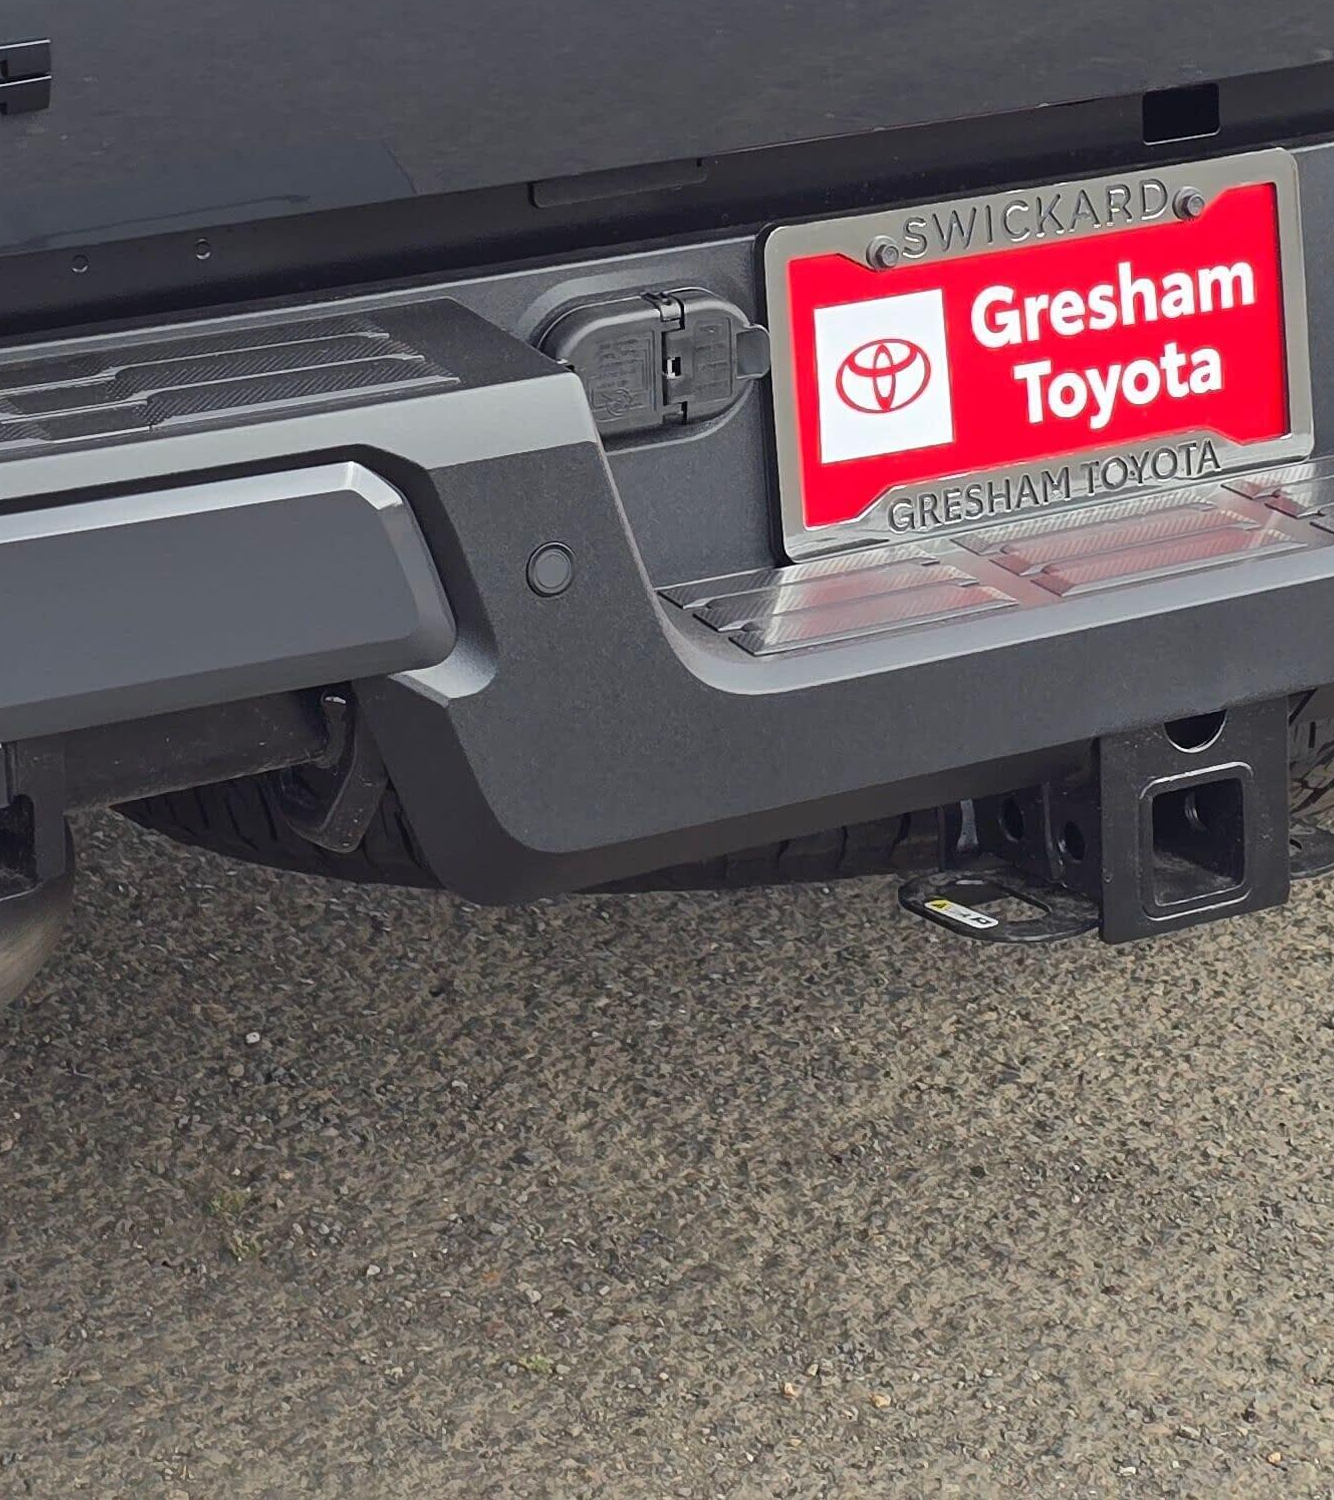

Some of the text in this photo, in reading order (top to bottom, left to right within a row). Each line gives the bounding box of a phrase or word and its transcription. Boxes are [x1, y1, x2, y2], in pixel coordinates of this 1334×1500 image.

[901, 177, 1169, 260] SWICKARD
[970, 260, 1256, 349] Gresham
[1013, 342, 1224, 430] Toyota
[887, 439, 1222, 535] GRESHAM TOYOTA
